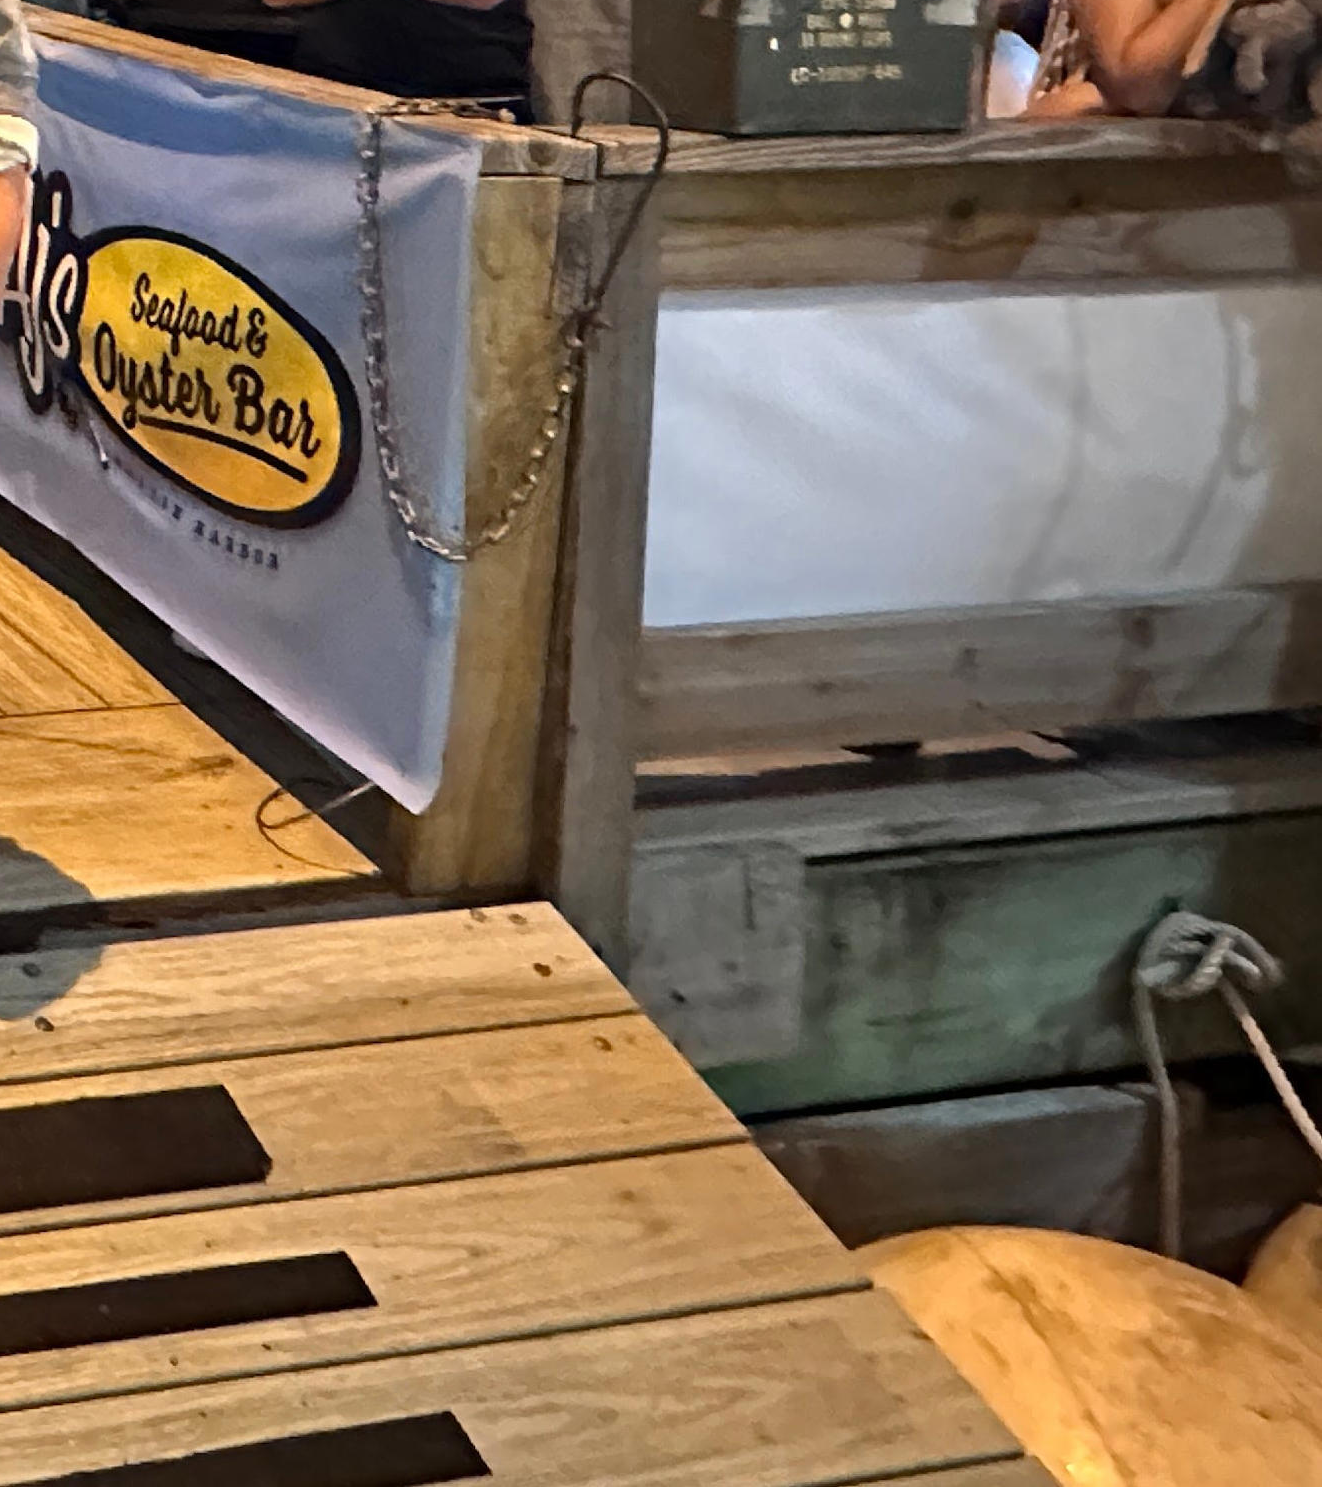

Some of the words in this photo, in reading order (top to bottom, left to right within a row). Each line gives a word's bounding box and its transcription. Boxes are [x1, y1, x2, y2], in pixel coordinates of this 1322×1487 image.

[130, 272, 242, 357] Seafood
[247, 307, 267, 359] &
[94, 321, 221, 430] Oyster
[227, 363, 322, 459] Bar
